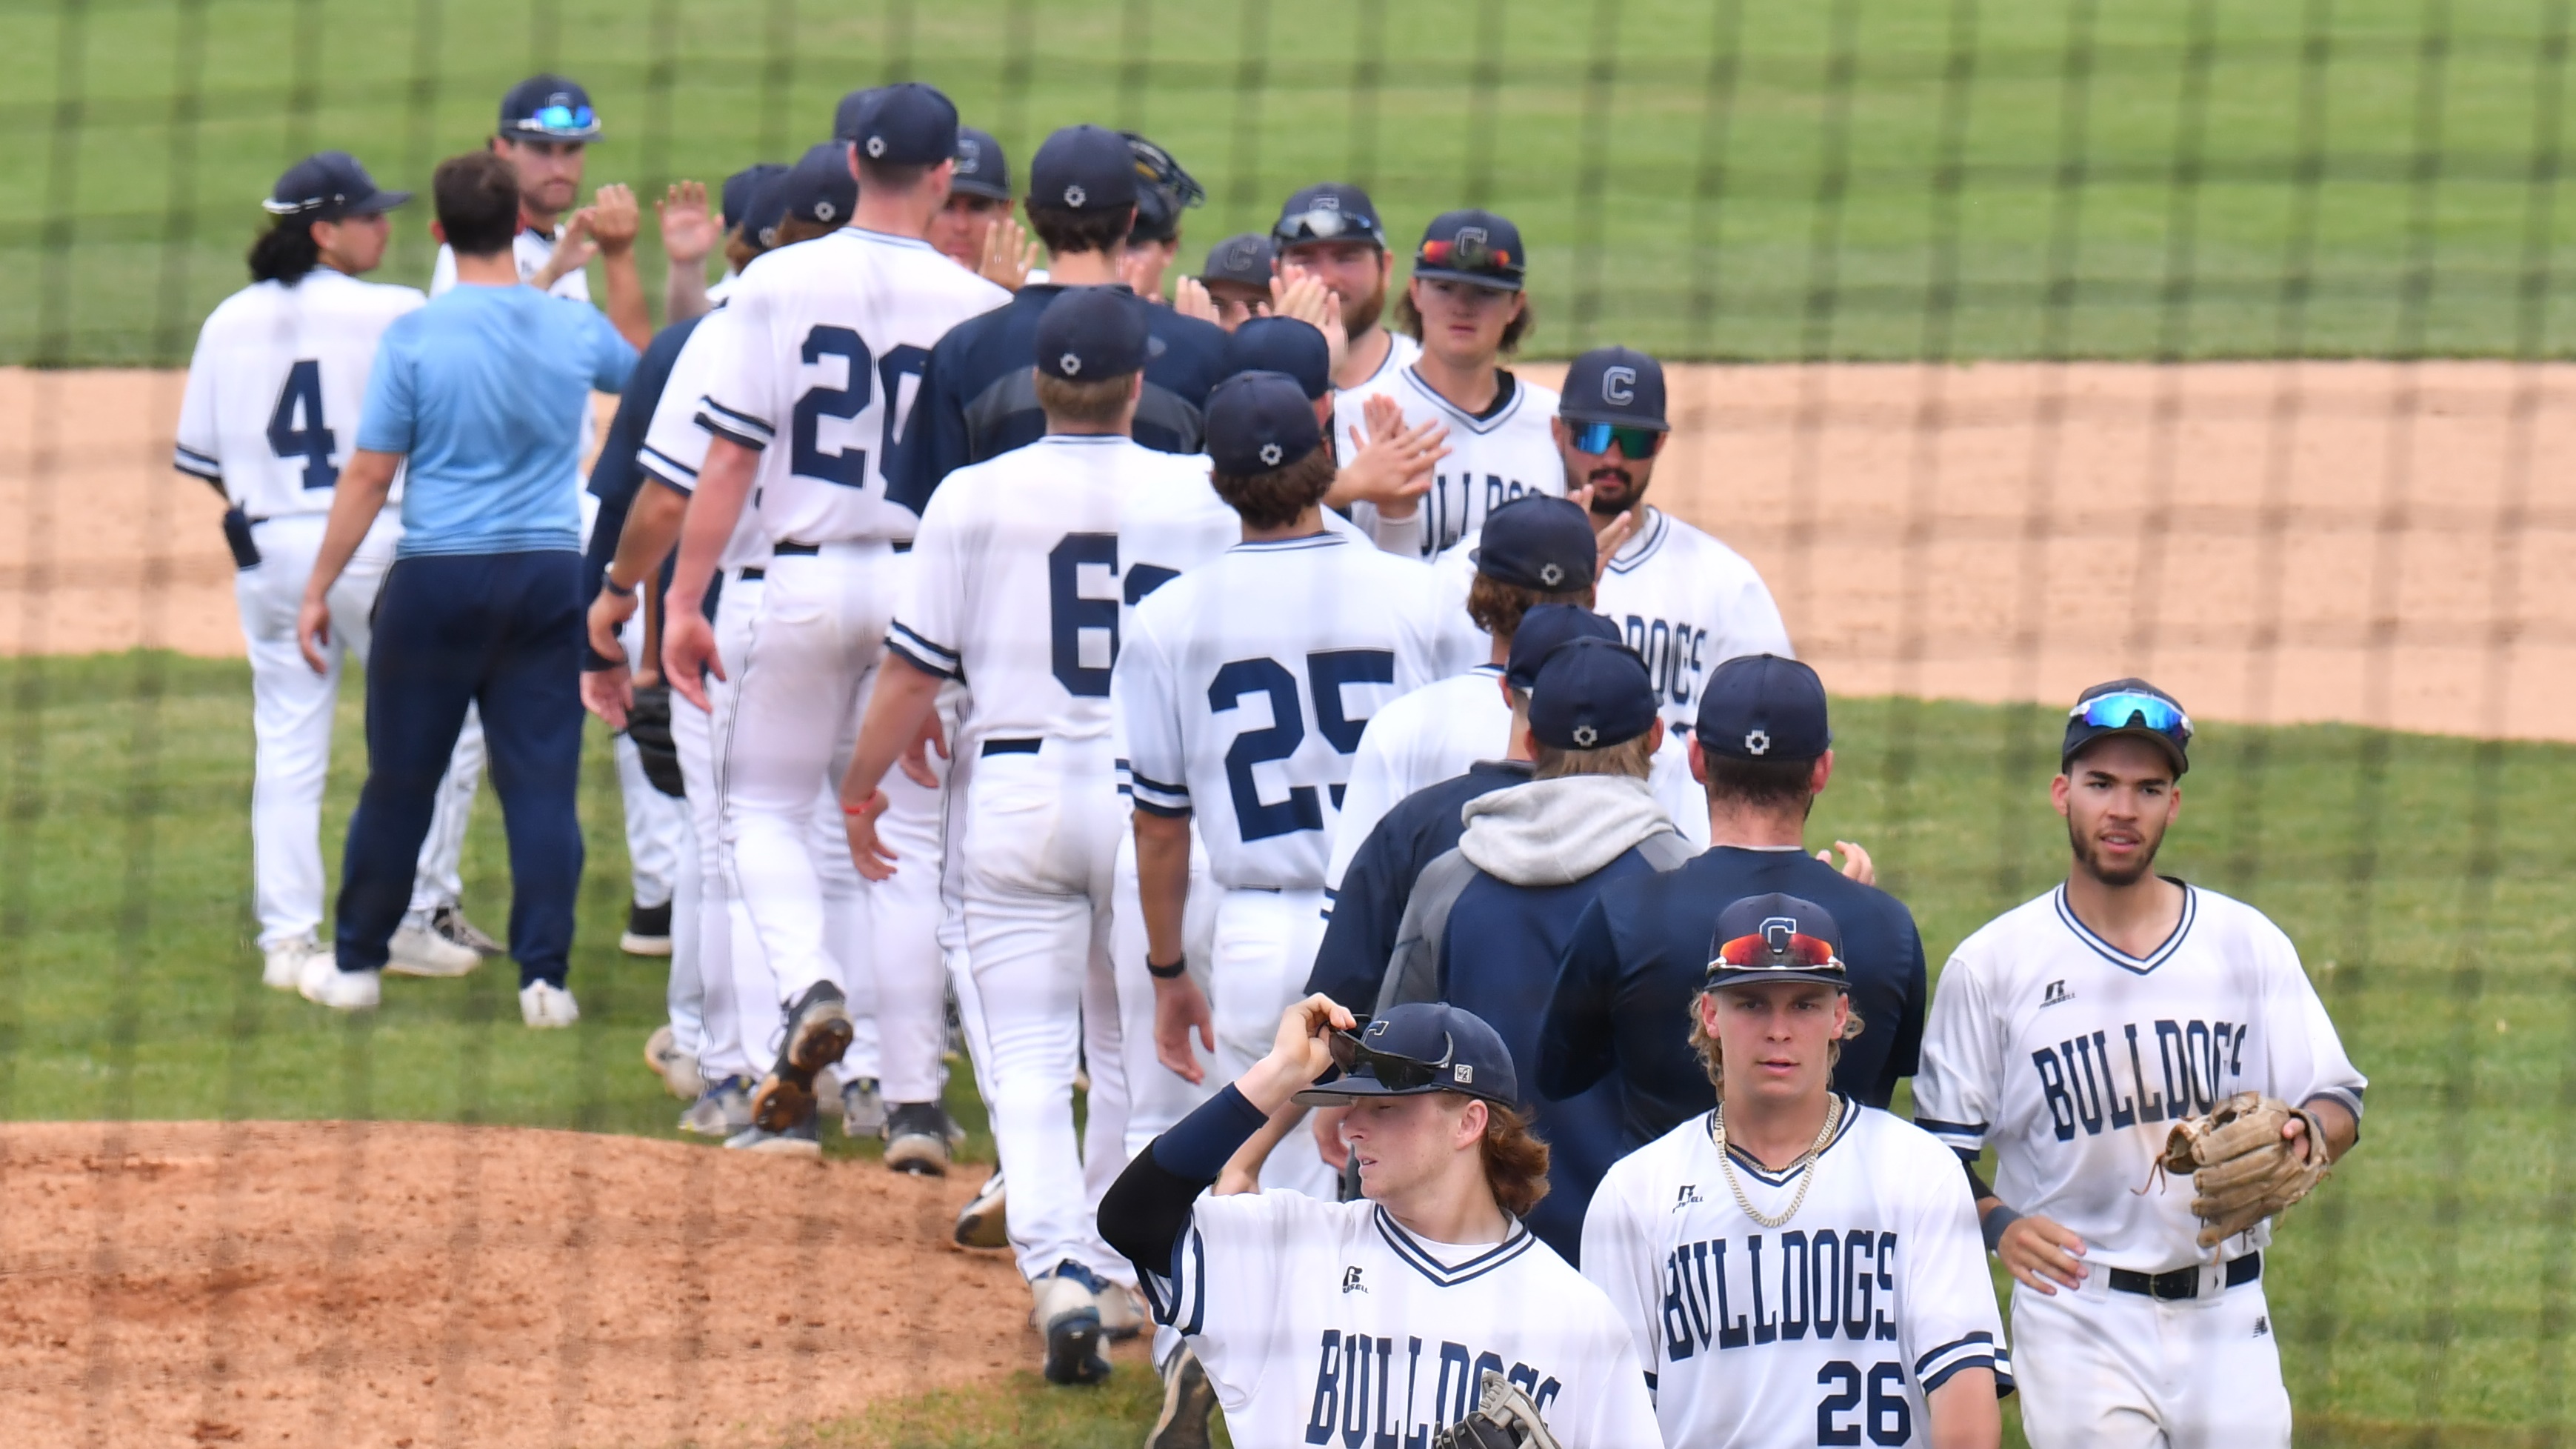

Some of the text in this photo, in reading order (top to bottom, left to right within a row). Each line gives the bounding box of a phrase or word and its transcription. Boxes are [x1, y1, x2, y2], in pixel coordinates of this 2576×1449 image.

[266, 359, 339, 490] 4
[1601, 365, 1636, 407] C
[1207, 647, 1395, 843] 25
[1759, 916, 1797, 954] C
[1663, 1228, 1898, 1363] BULLDOGS
[1817, 1360, 1912, 1447] 26
